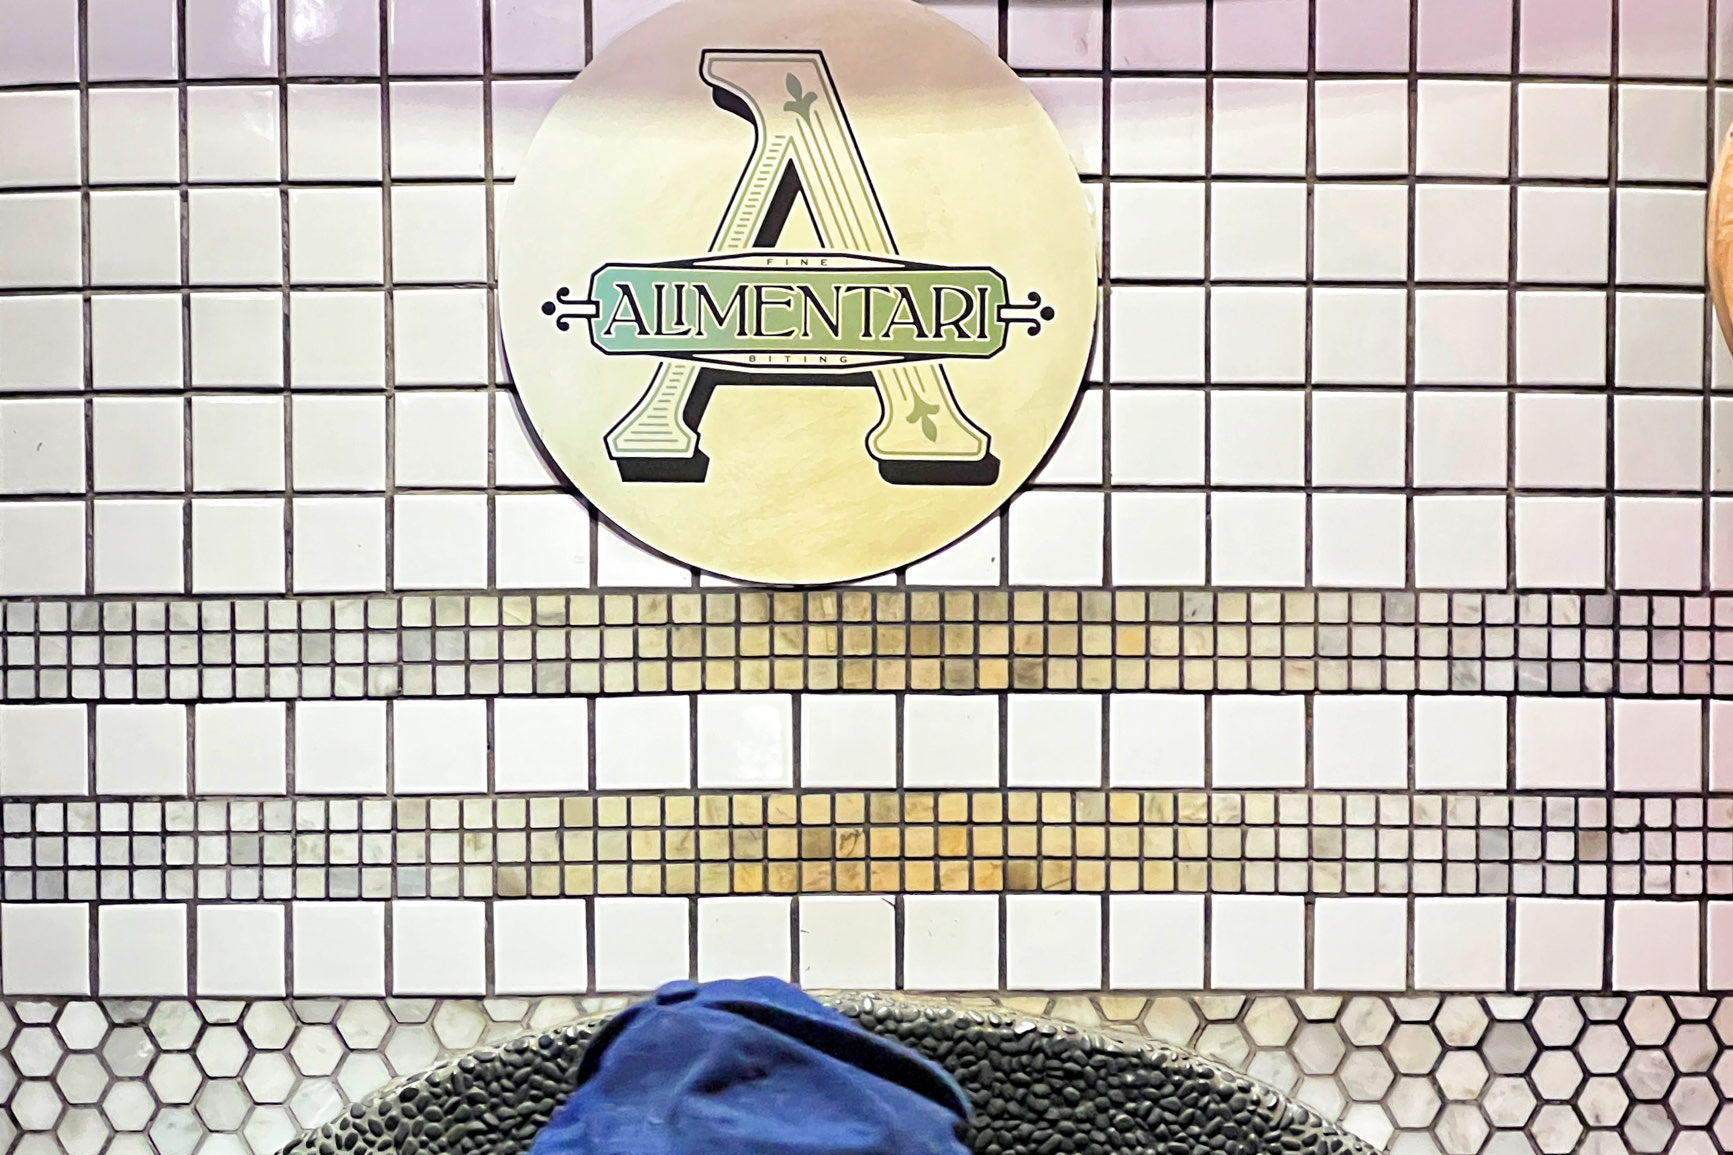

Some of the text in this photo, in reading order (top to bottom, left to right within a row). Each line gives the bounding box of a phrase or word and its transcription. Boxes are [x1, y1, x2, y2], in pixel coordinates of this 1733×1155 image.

[604, 49, 1000, 485] A
[766, 258, 829, 267] FINE
[603, 283, 989, 340] ALIMENTARI
[749, 355, 849, 364] BITING
